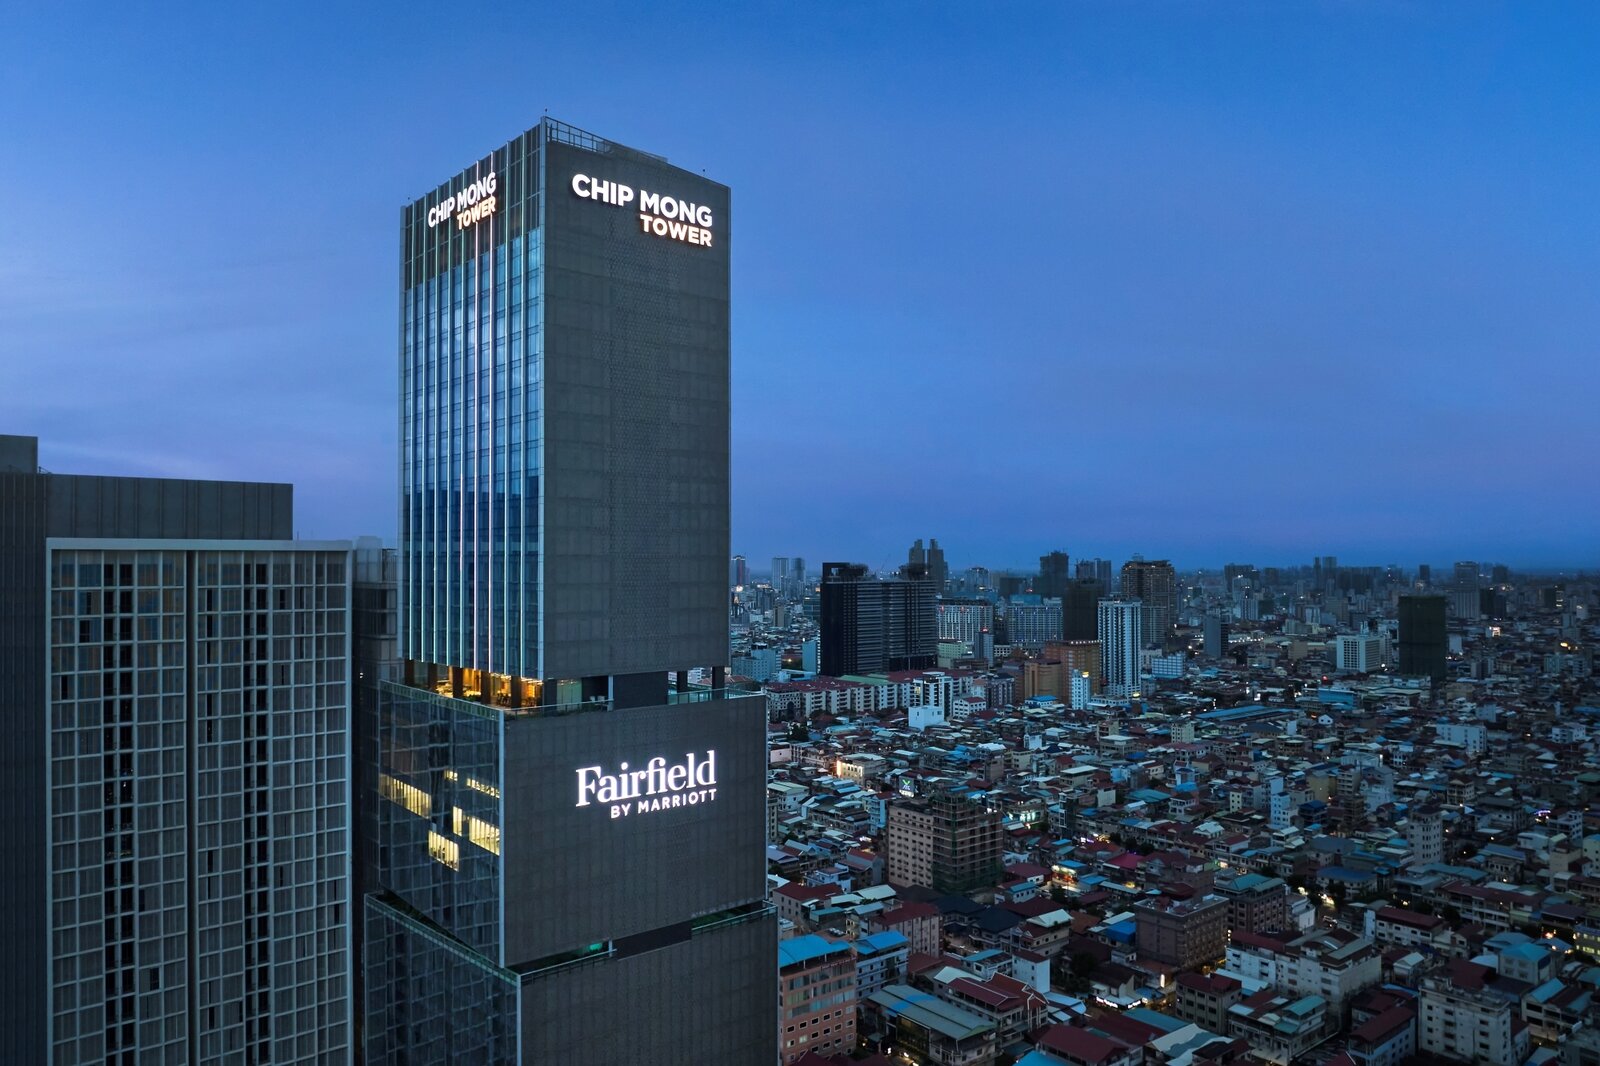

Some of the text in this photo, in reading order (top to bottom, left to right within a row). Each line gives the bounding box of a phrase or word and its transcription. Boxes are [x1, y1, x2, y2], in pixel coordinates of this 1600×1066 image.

[428, 172, 496, 228] CHIP MONG
[457, 196, 496, 230] TOWER
[572, 174, 712, 227] CHIP MONG
[640, 214, 712, 247] TOWER
[576, 750, 716, 807] Fairfield
[611, 788, 717, 818] BY MARRIOTT
